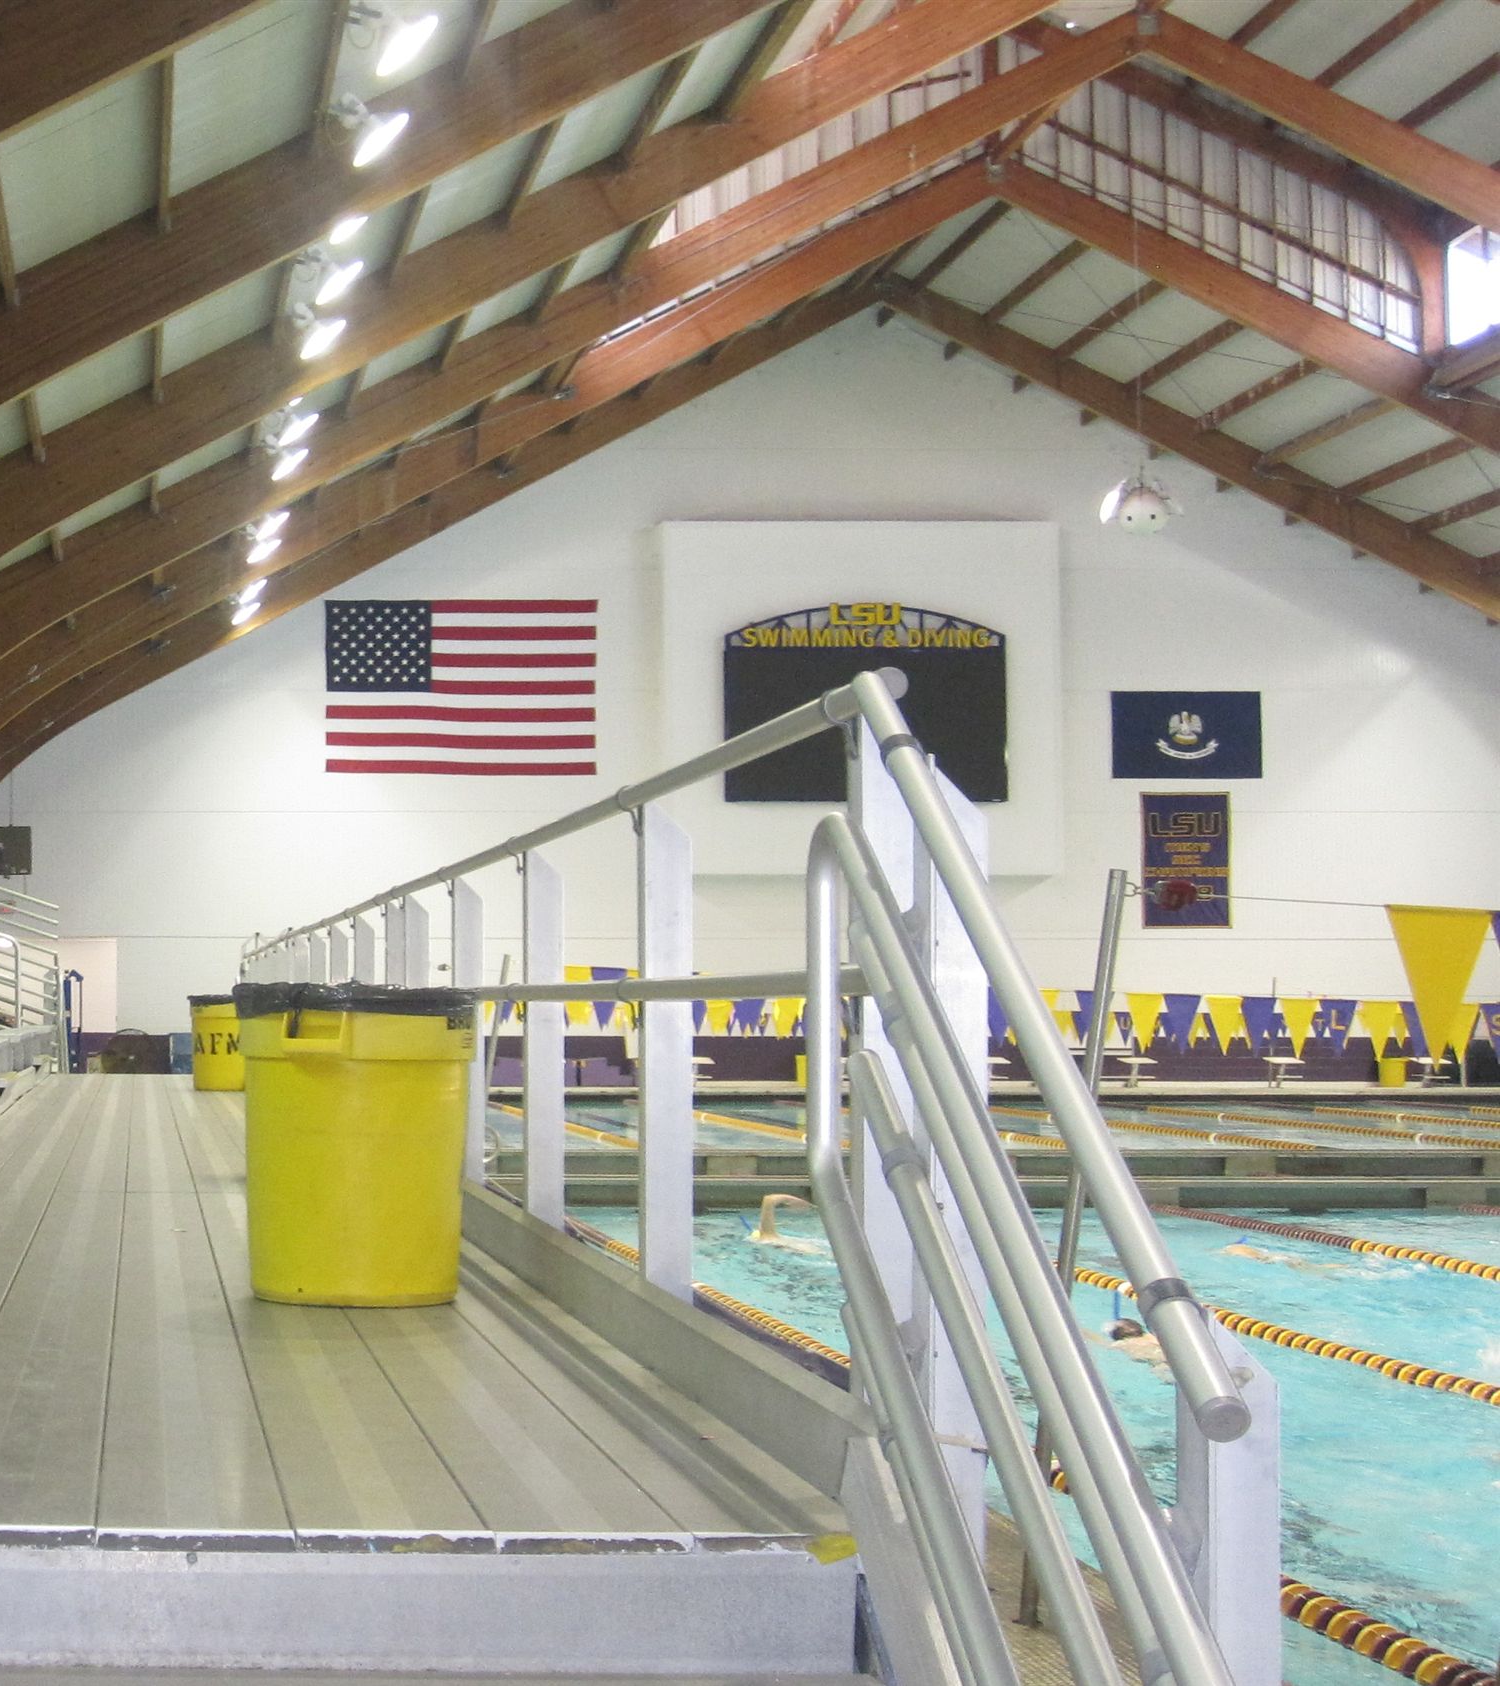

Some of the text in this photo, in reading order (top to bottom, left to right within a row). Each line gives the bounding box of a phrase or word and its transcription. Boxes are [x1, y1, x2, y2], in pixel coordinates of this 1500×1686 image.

[829, 602, 901, 626] LSU
[742, 627, 991, 649] SWIMMING & DIVING
[1149, 811, 1221, 837] LSU
